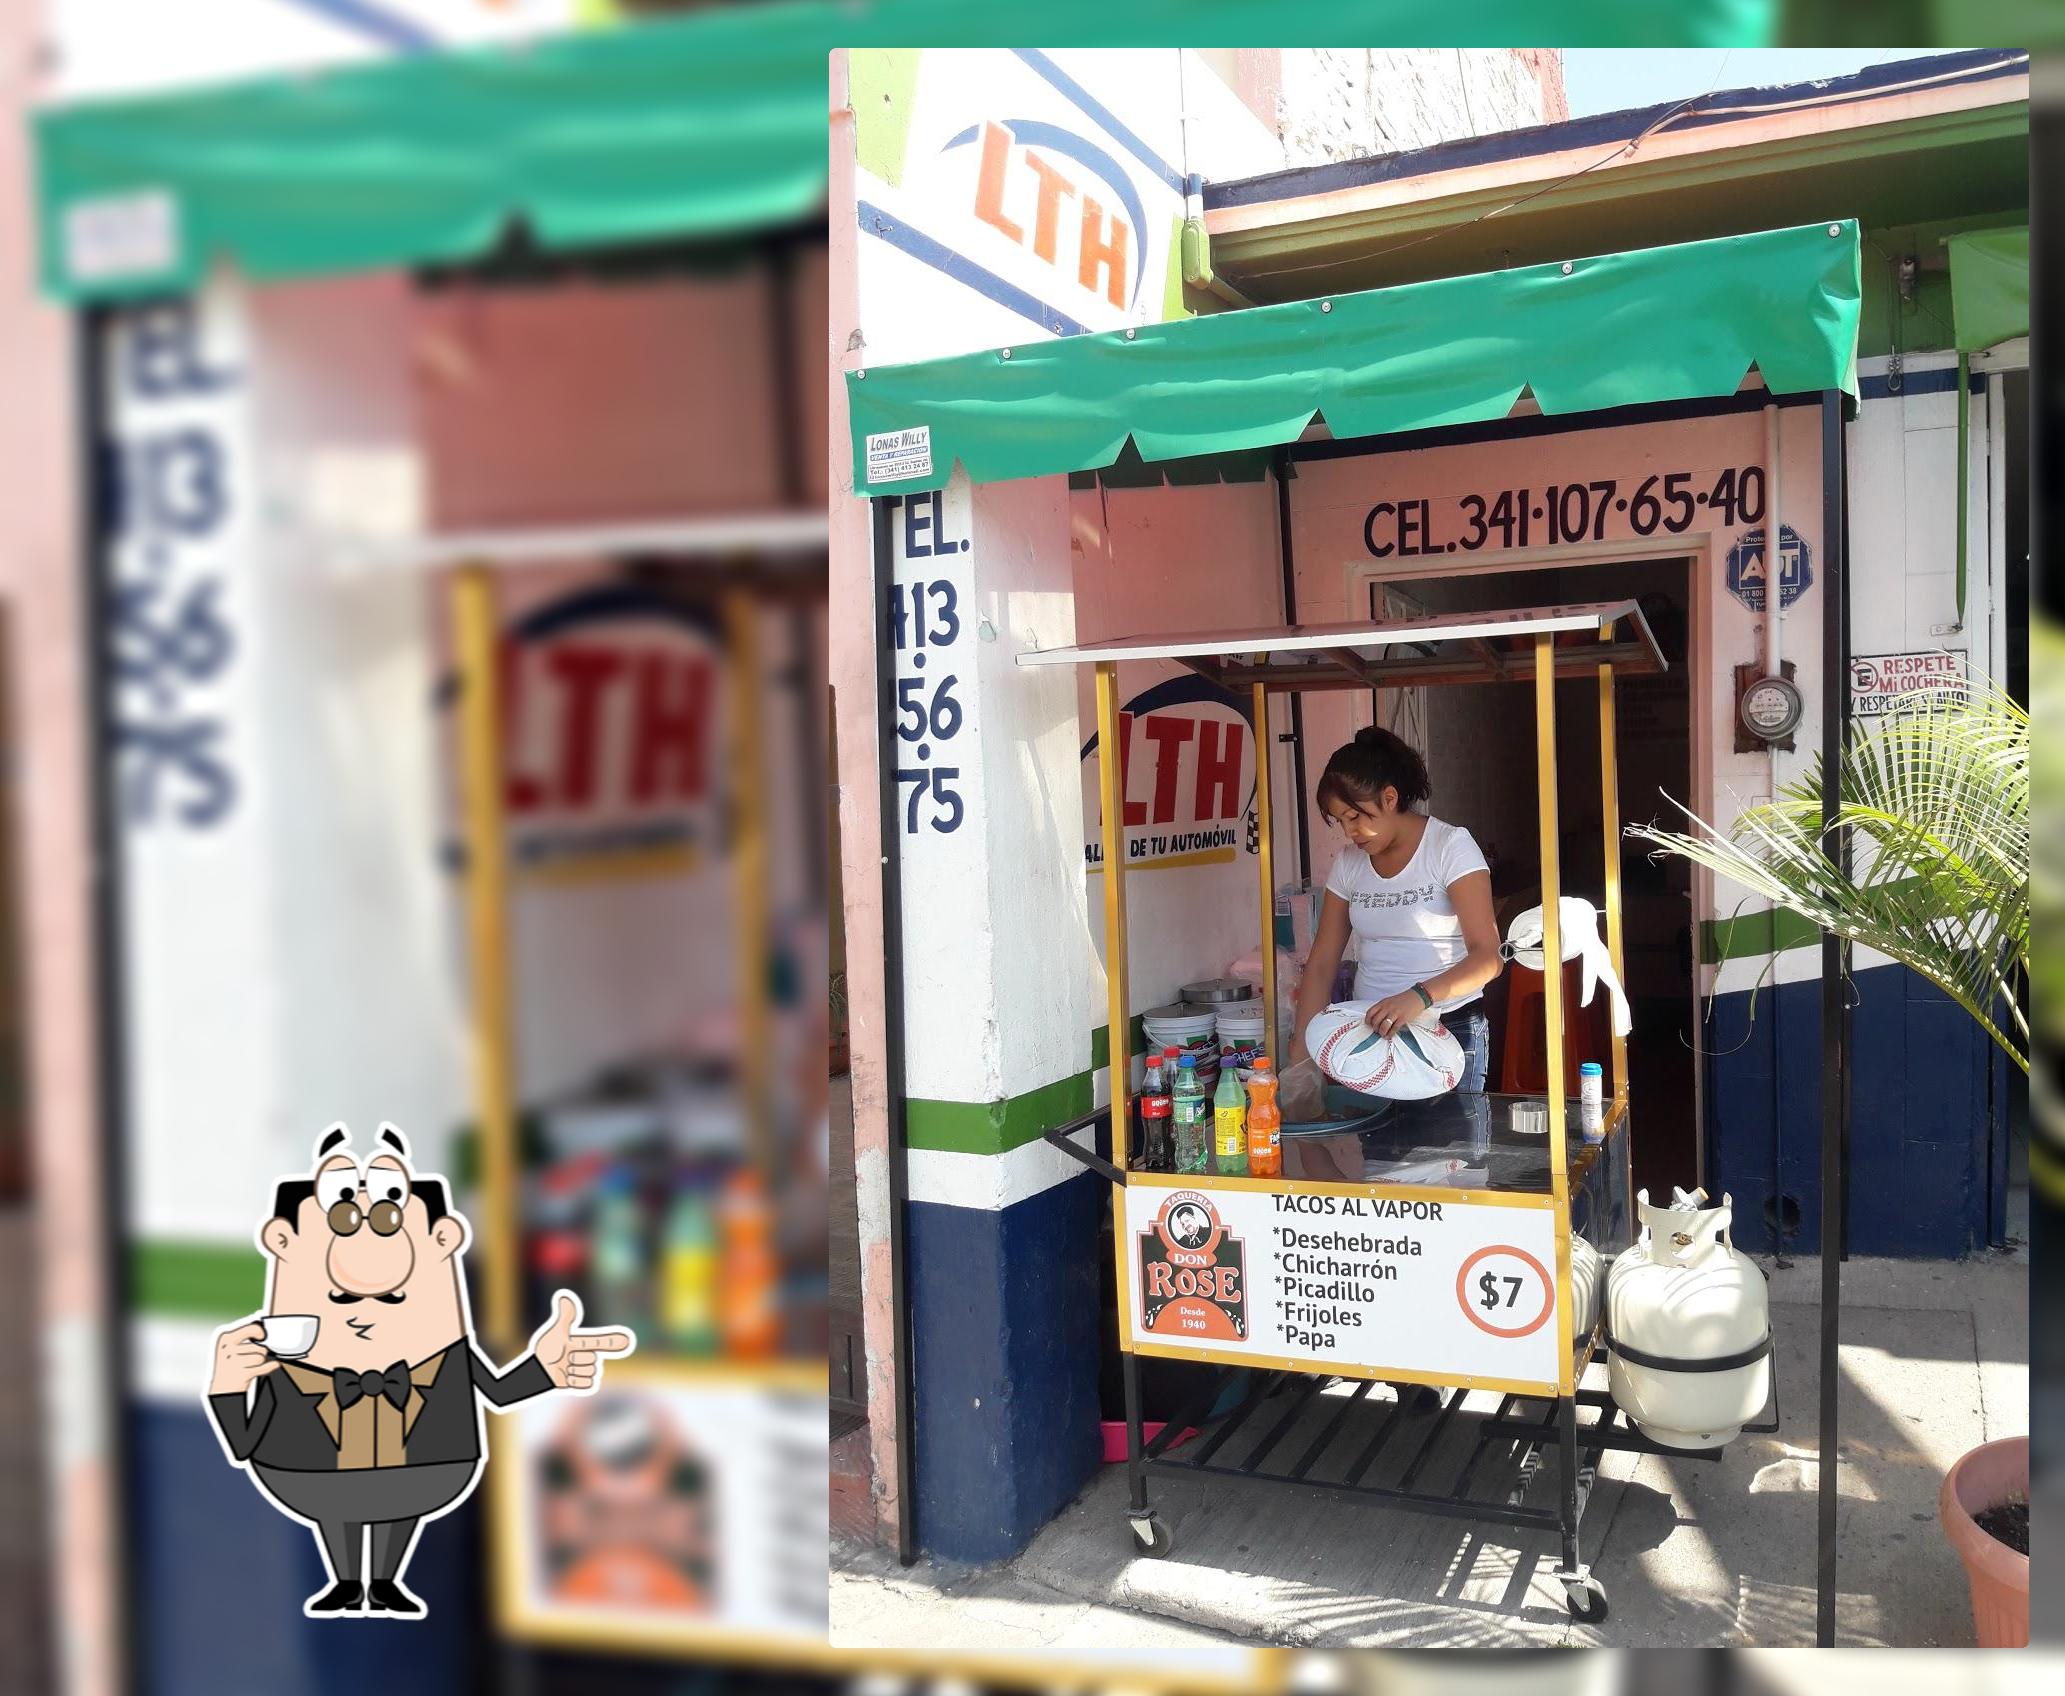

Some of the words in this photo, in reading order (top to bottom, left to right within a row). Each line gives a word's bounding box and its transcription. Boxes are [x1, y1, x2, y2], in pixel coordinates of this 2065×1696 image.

[975, 119, 1126, 312] LTH
[871, 437, 899, 451] LONAS
[902, 432, 927, 447] WILLY
[1884, 656, 1956, 675] RESPETE
[893, 767, 964, 834] 75
[1130, 838, 1147, 857] DE
[1151, 836, 1167, 855] TU
[1170, 824, 1236, 853] AUTOMÓVIL
[1272, 1194, 1336, 1215] TACOS
[1342, 1197, 1368, 1217] AL
[1372, 1199, 1443, 1221] VAPOR
[1174, 1253, 1207, 1266] DON
[1480, 1271, 1523, 1310] $7
[1180, 1306, 1206, 1317] Desde
[1181, 1319, 1206, 1330] 1940
